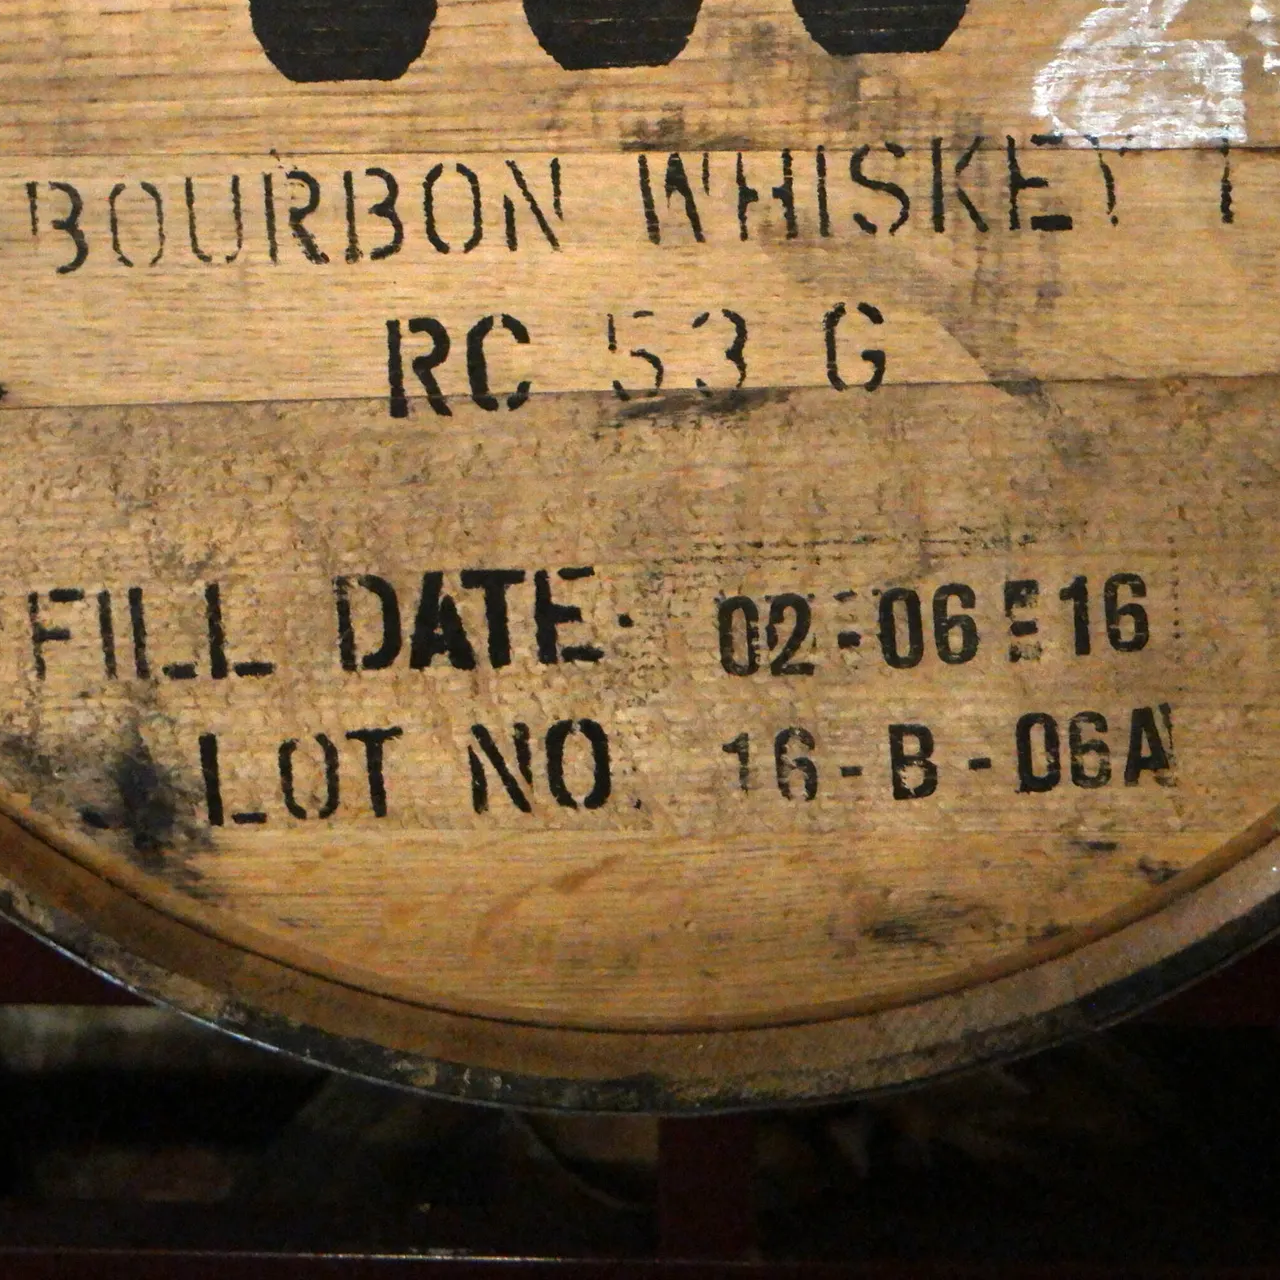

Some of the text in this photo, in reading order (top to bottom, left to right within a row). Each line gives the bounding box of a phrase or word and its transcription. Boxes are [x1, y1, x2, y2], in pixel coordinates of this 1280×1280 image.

[25, 156, 563, 274] BOURBON
[385, 312, 531, 418] RC
[822, 301, 887, 393] G
[26, 583, 276, 681] FILL
[197, 726, 404, 827] LOT
